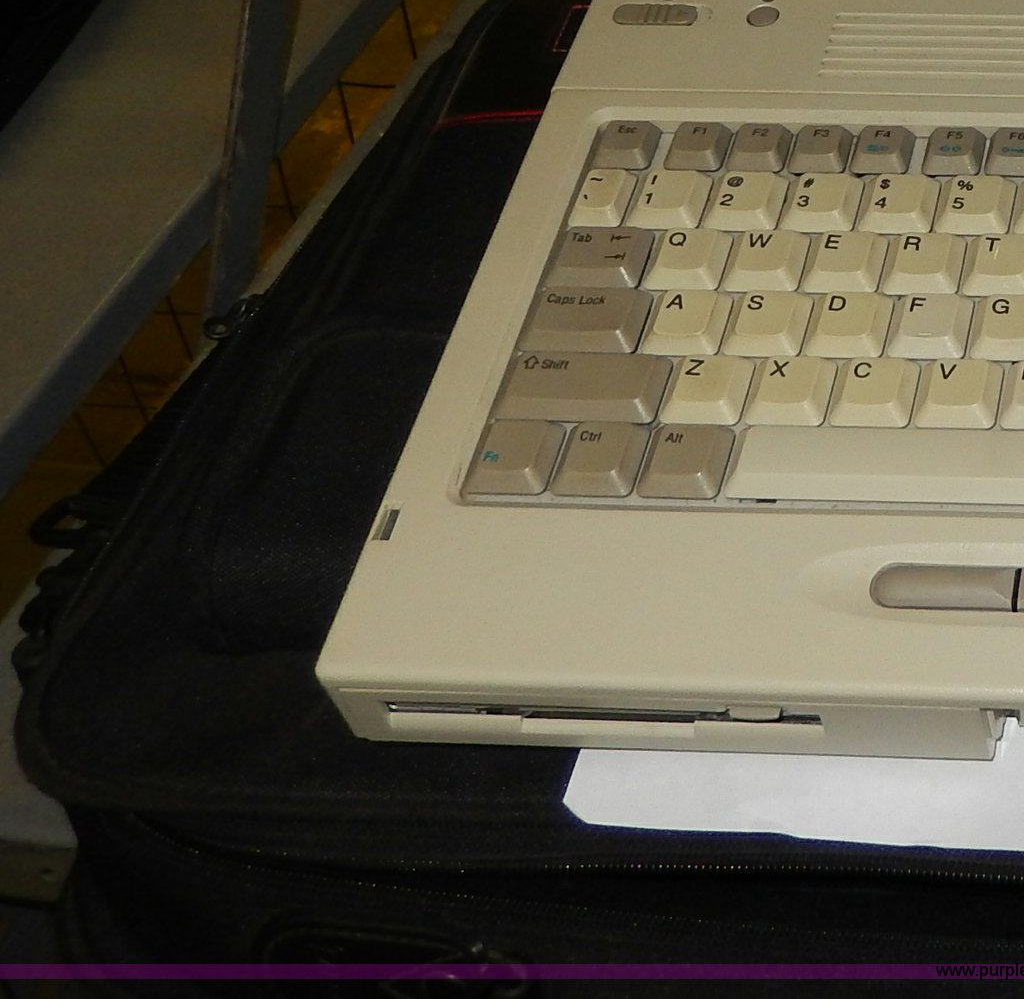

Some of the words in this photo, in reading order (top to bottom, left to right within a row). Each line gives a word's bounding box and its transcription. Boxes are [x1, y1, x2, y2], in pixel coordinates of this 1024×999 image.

[617, 125, 638, 135] Esc
[693, 126, 707, 135] F1
[752, 128, 769, 137] F2
[813, 129, 830, 138] F3
[875, 130, 891, 139] F4
[946, 131, 964, 140] F5
[727, 177, 744, 188] @
[804, 178, 815, 189] #
[879, 178, 891, 190] $
[957, 180, 974, 192] %
[645, 192, 653, 205] 1
[719, 194, 734, 207] 2
[797, 195, 810, 208] 3
[874, 197, 888, 209] 4
[951, 197, 965, 210] 5
[572, 232, 593, 243] Tab
[668, 232, 688, 248] Q
[749, 233, 773, 249] W
[824, 235, 843, 250] E
[903, 236, 922, 251] R
[985, 237, 1001, 252] T
[546, 293, 576, 306] Caps
[579, 294, 607, 306] Lock
[666, 294, 684, 310] A
[748, 295, 765, 311] S
[828, 296, 847, 311] D
[909, 297, 927, 312] F
[992, 299, 1011, 315] G
[540, 358, 570, 371] Shift
[685, 359, 705, 377] Z
[769, 360, 791, 378] X
[853, 362, 873, 379] C
[939, 363, 958, 380] V
[579, 430, 603, 443] Ctrl
[664, 431, 684, 444] Alt
[482, 451, 500, 463] Fn
